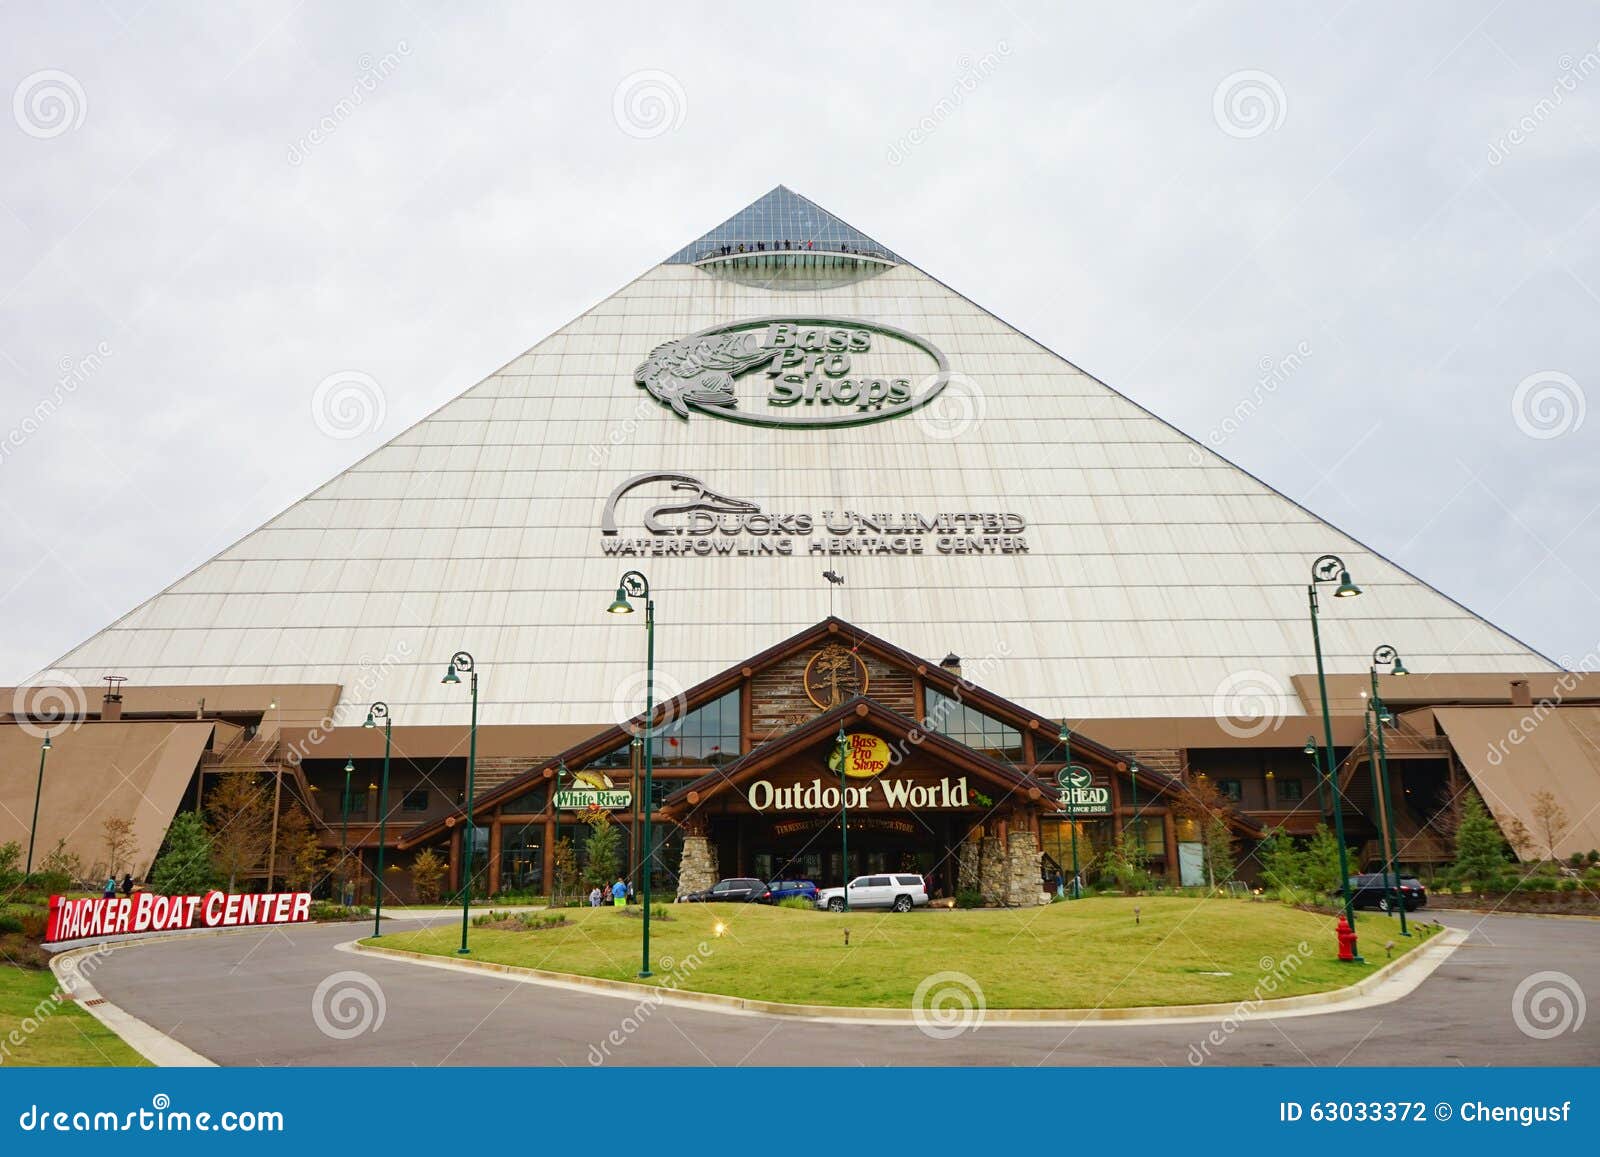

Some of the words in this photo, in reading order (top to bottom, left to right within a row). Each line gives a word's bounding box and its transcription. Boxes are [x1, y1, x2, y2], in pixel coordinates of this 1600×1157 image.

[760, 323, 871, 351] Bass
[766, 350, 851, 378] Pro
[767, 371, 911, 411] Shops
[688, 512, 813, 535] DUCKS
[822, 511, 1026, 535] UNLIMITED
[600, 538, 793, 556] WATERFOWLING
[808, 538, 924, 555] HERITAGE
[936, 537, 1029, 555] CENTER
[852, 735, 877, 748] Bass
[852, 747, 872, 759] Pro
[852, 759, 885, 772] Shops
[558, 791, 594, 806] White
[596, 791, 630, 806] River
[748, 778, 872, 810] Outdoor
[880, 776, 969, 809] World
[55, 895, 132, 941] TRACKER
[134, 893, 201, 931] BOAT
[206, 891, 312, 926] CENTER
